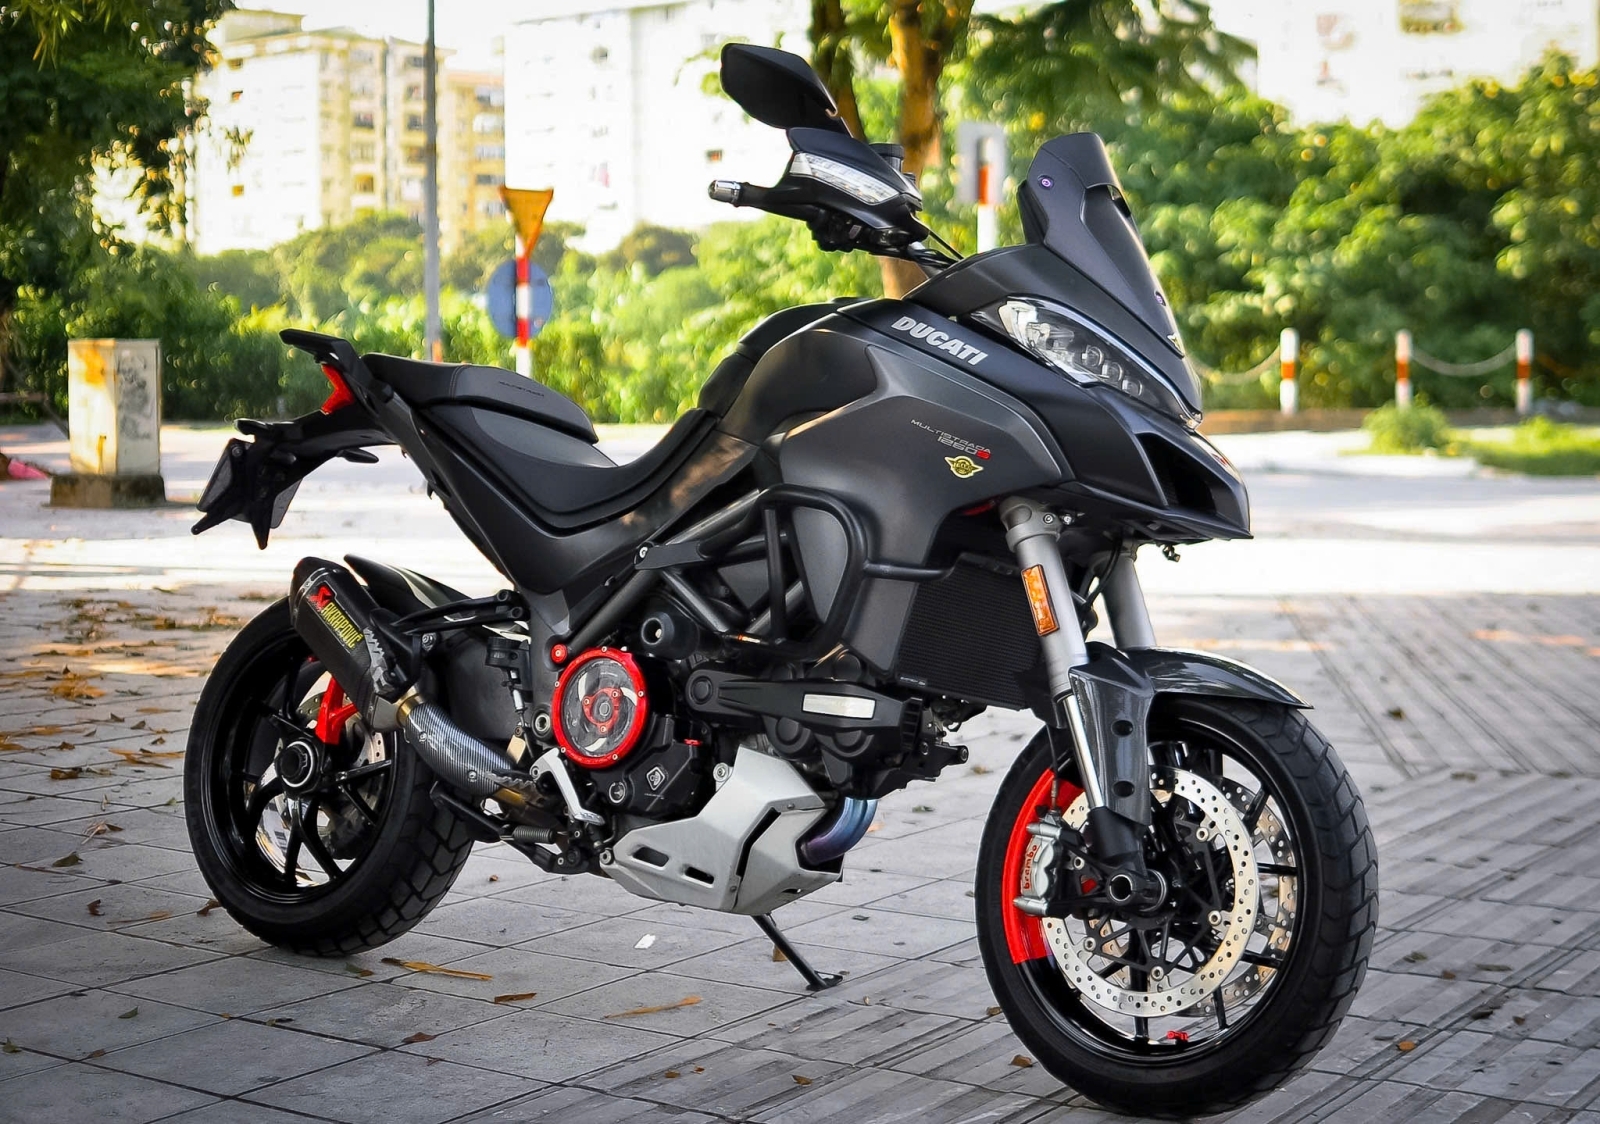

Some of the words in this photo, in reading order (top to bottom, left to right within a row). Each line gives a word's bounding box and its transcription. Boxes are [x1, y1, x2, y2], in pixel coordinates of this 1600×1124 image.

[891, 316, 988, 365] DUCATI
[911, 419, 991, 453] MULTISTRADA
[1023, 844, 1037, 889] brembo
